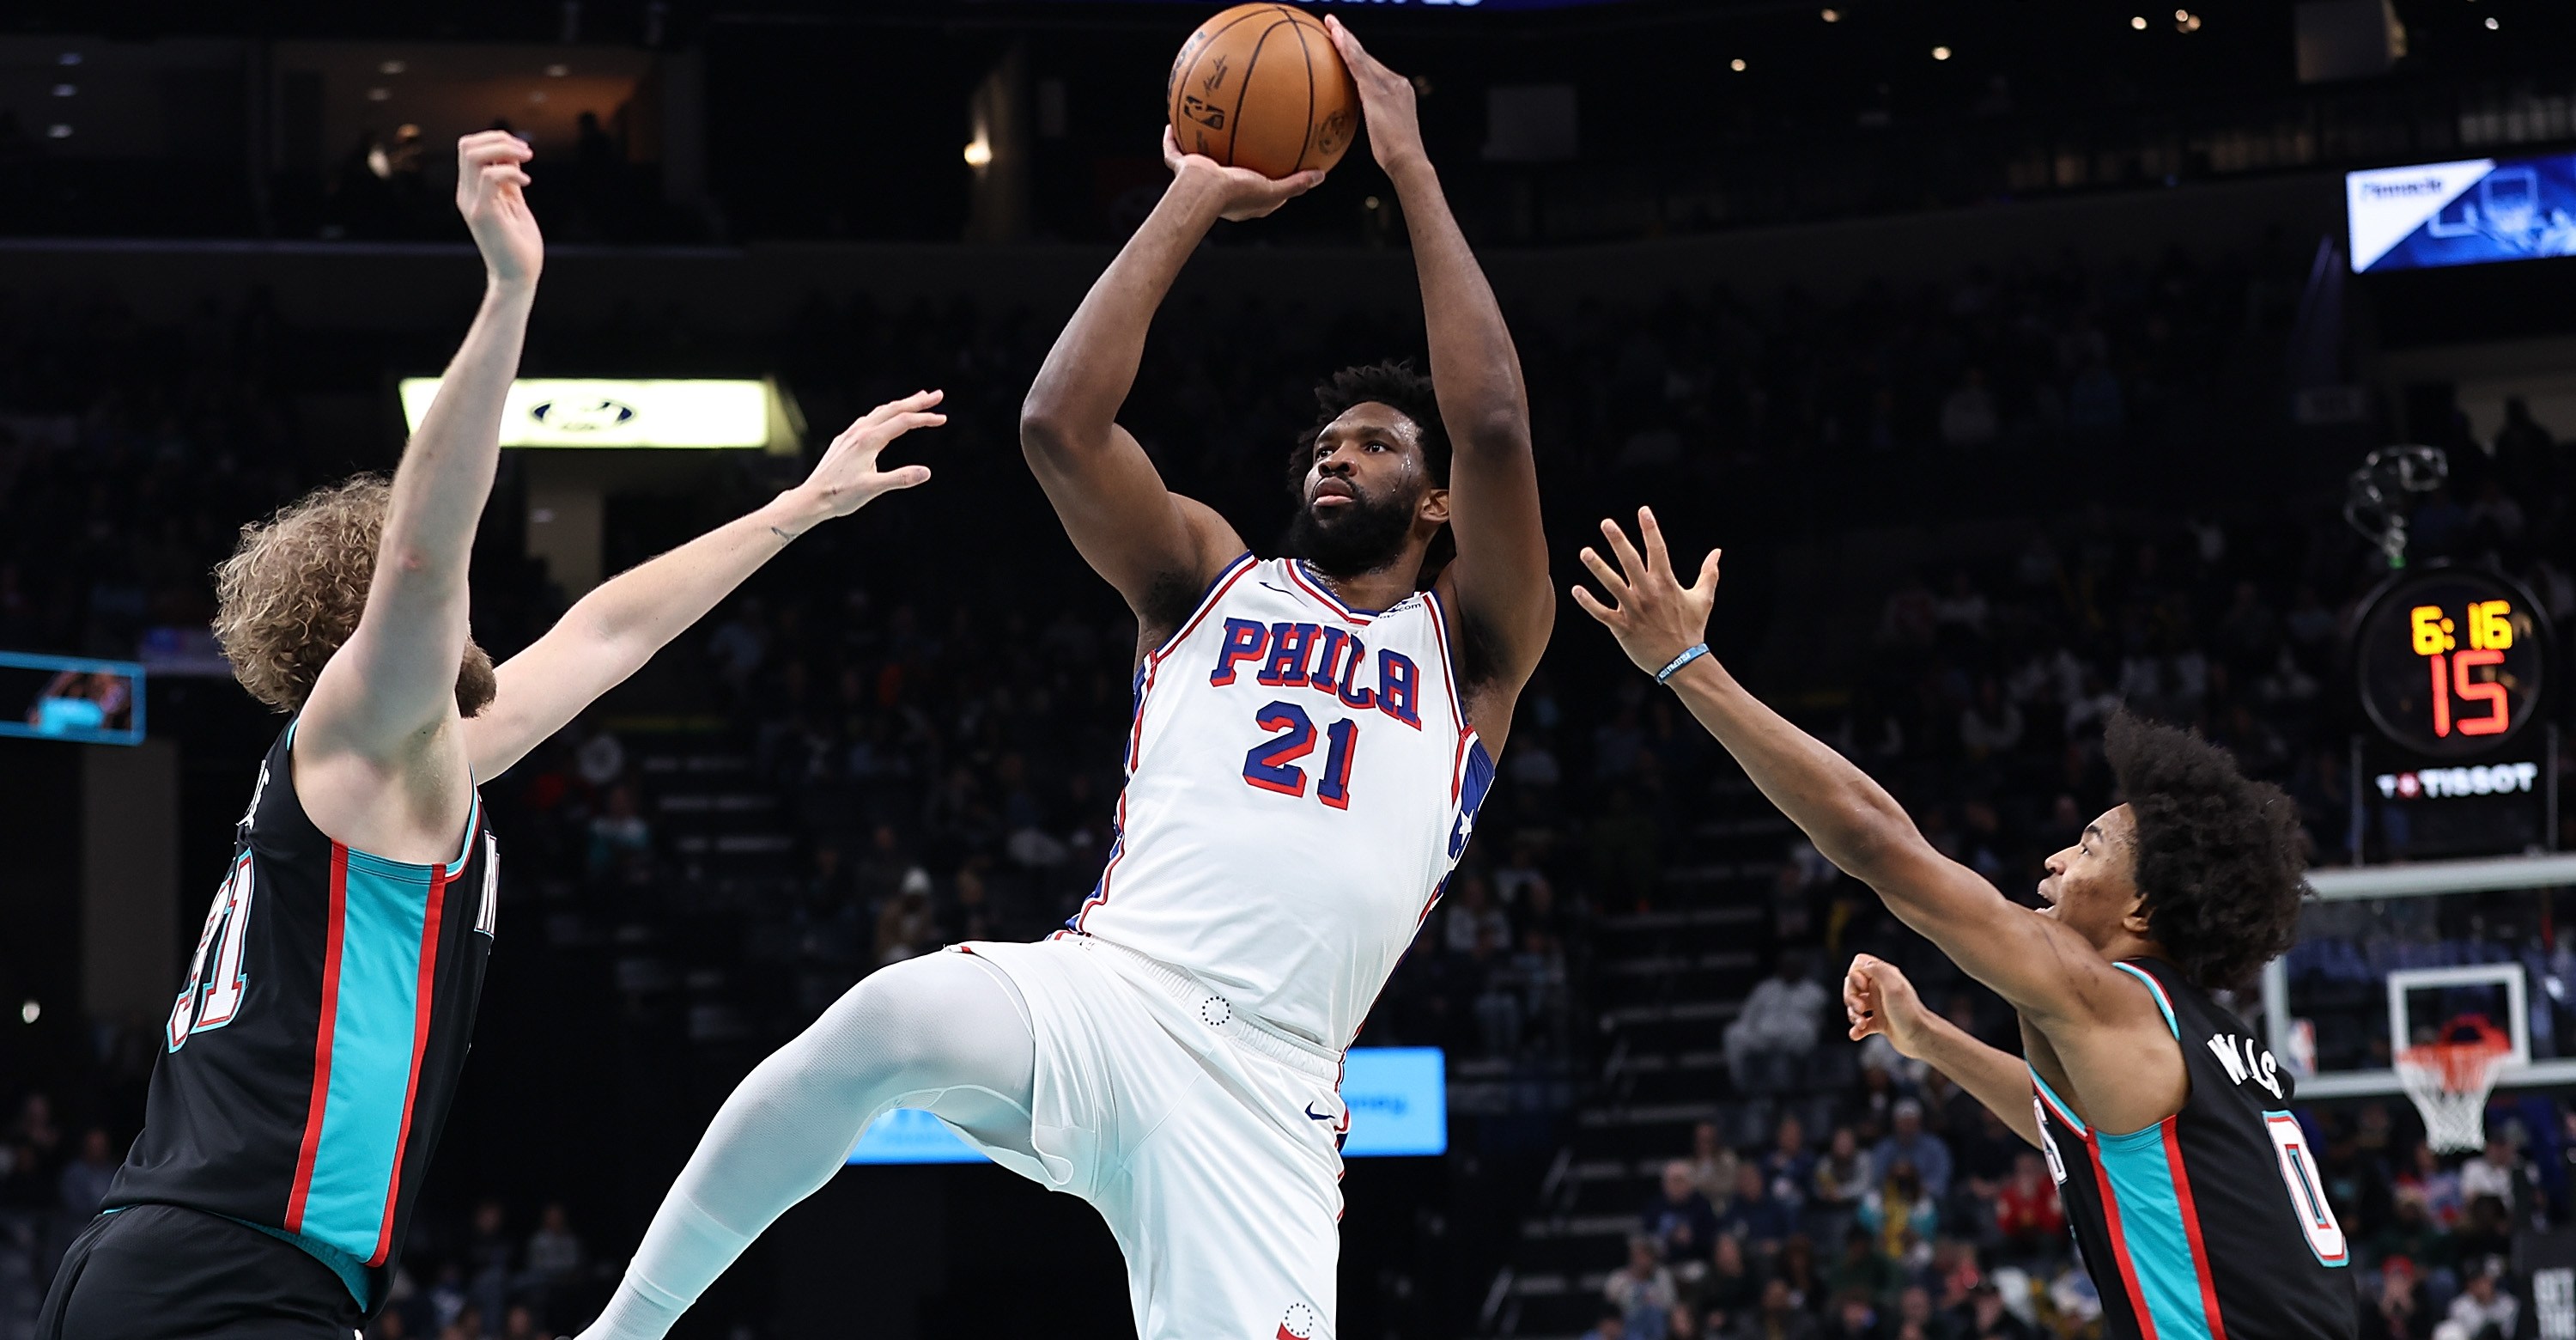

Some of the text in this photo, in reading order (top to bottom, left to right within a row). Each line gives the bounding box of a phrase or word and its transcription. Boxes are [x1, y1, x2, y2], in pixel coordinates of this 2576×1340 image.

[1210, 617, 1422, 731] PHILA
[2410, 600, 2512, 655] 6:16
[2429, 649, 2509, 738] 15
[1242, 700, 1358, 810] 21
[2417, 762, 2538, 799] TISSOT
[2262, 1110, 2350, 1267] 0
